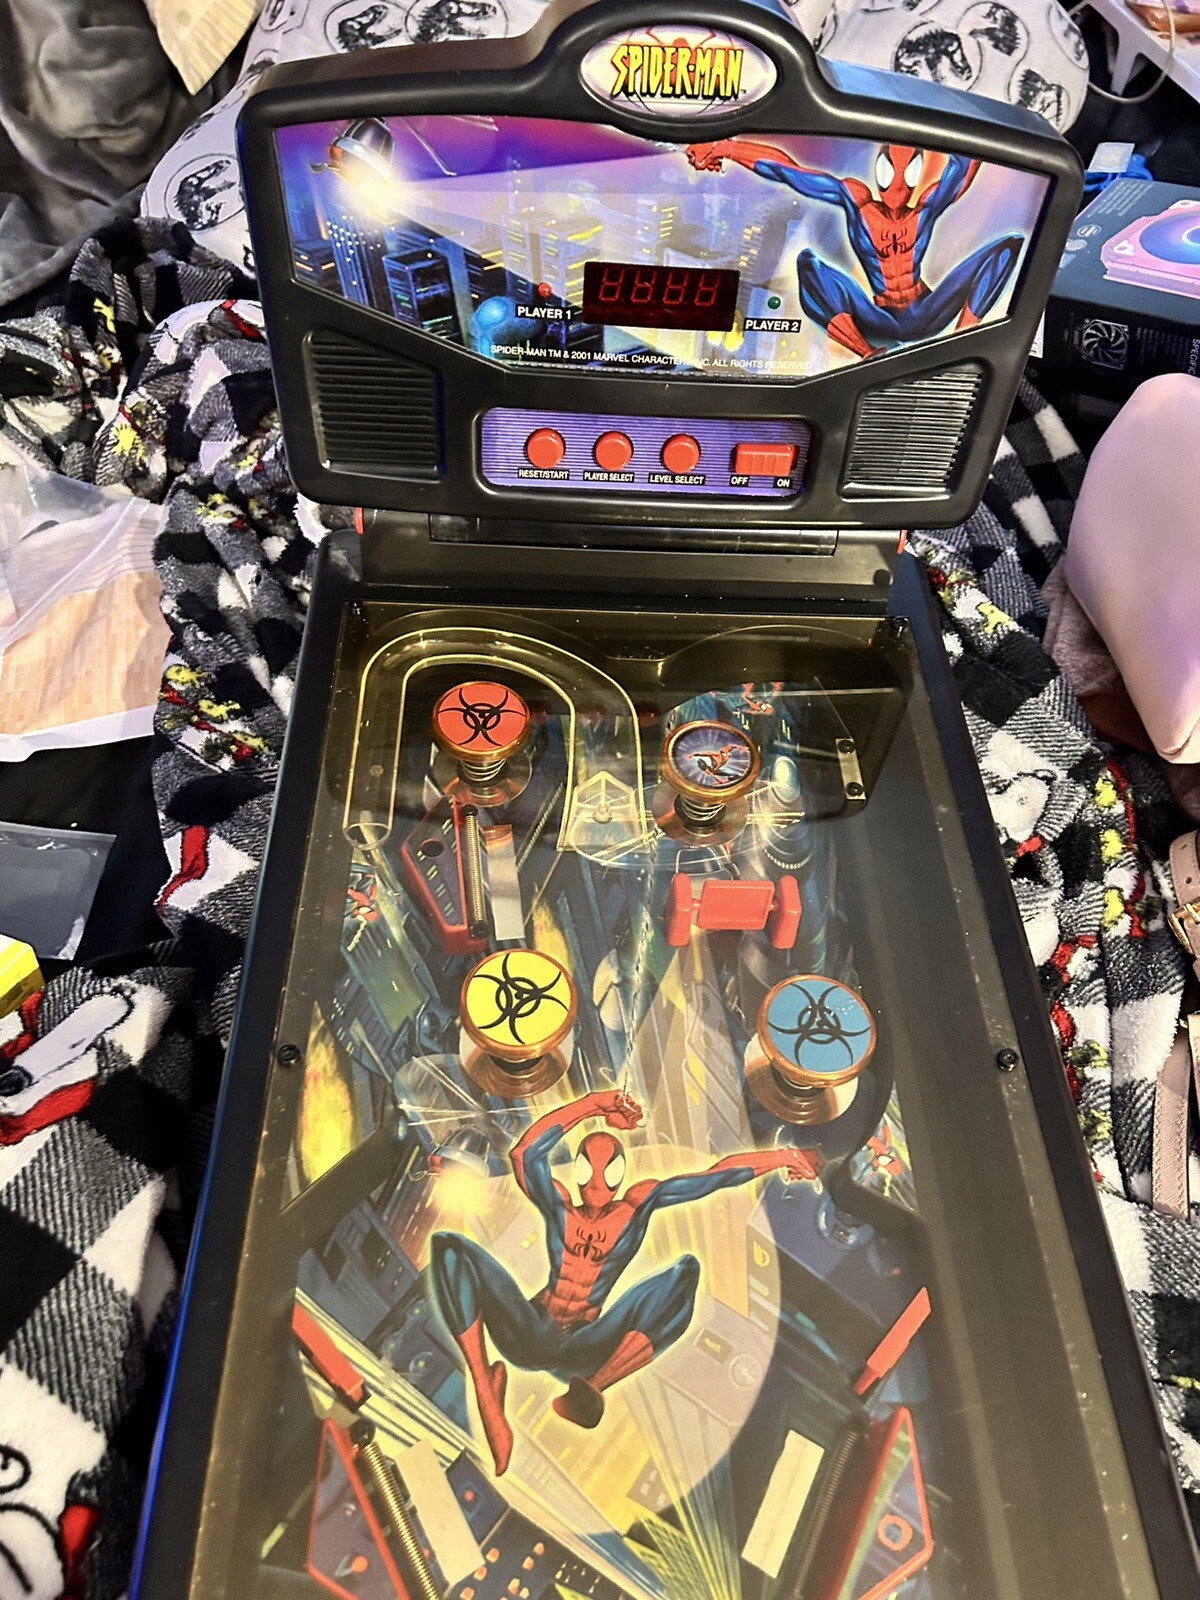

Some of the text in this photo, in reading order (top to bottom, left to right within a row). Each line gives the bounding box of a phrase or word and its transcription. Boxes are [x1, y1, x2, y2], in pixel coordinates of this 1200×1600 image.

[517, 306, 572, 319] PLAYER 1
[745, 319, 799, 332] PLAYER 2
[490, 345, 546, 357] SPIDER-MAN
[547, 348, 561, 358] TM
[563, 351, 570, 359] &
[571, 351, 591, 360] 2001
[593, 352, 629, 362] MARVEL
[693, 356, 711, 367] NC.
[712, 358, 729, 368] ALL
[730, 358, 764, 369] RIGHTS
[764, 360, 813, 370] RESERVED
[519, 469, 569, 479] RESET/START
[584, 472, 633, 482] PLAYER SELECT
[650, 474, 705, 485] LEVEL SELECT
[731, 476, 748, 485] OFF
[777, 479, 790, 487] ON
